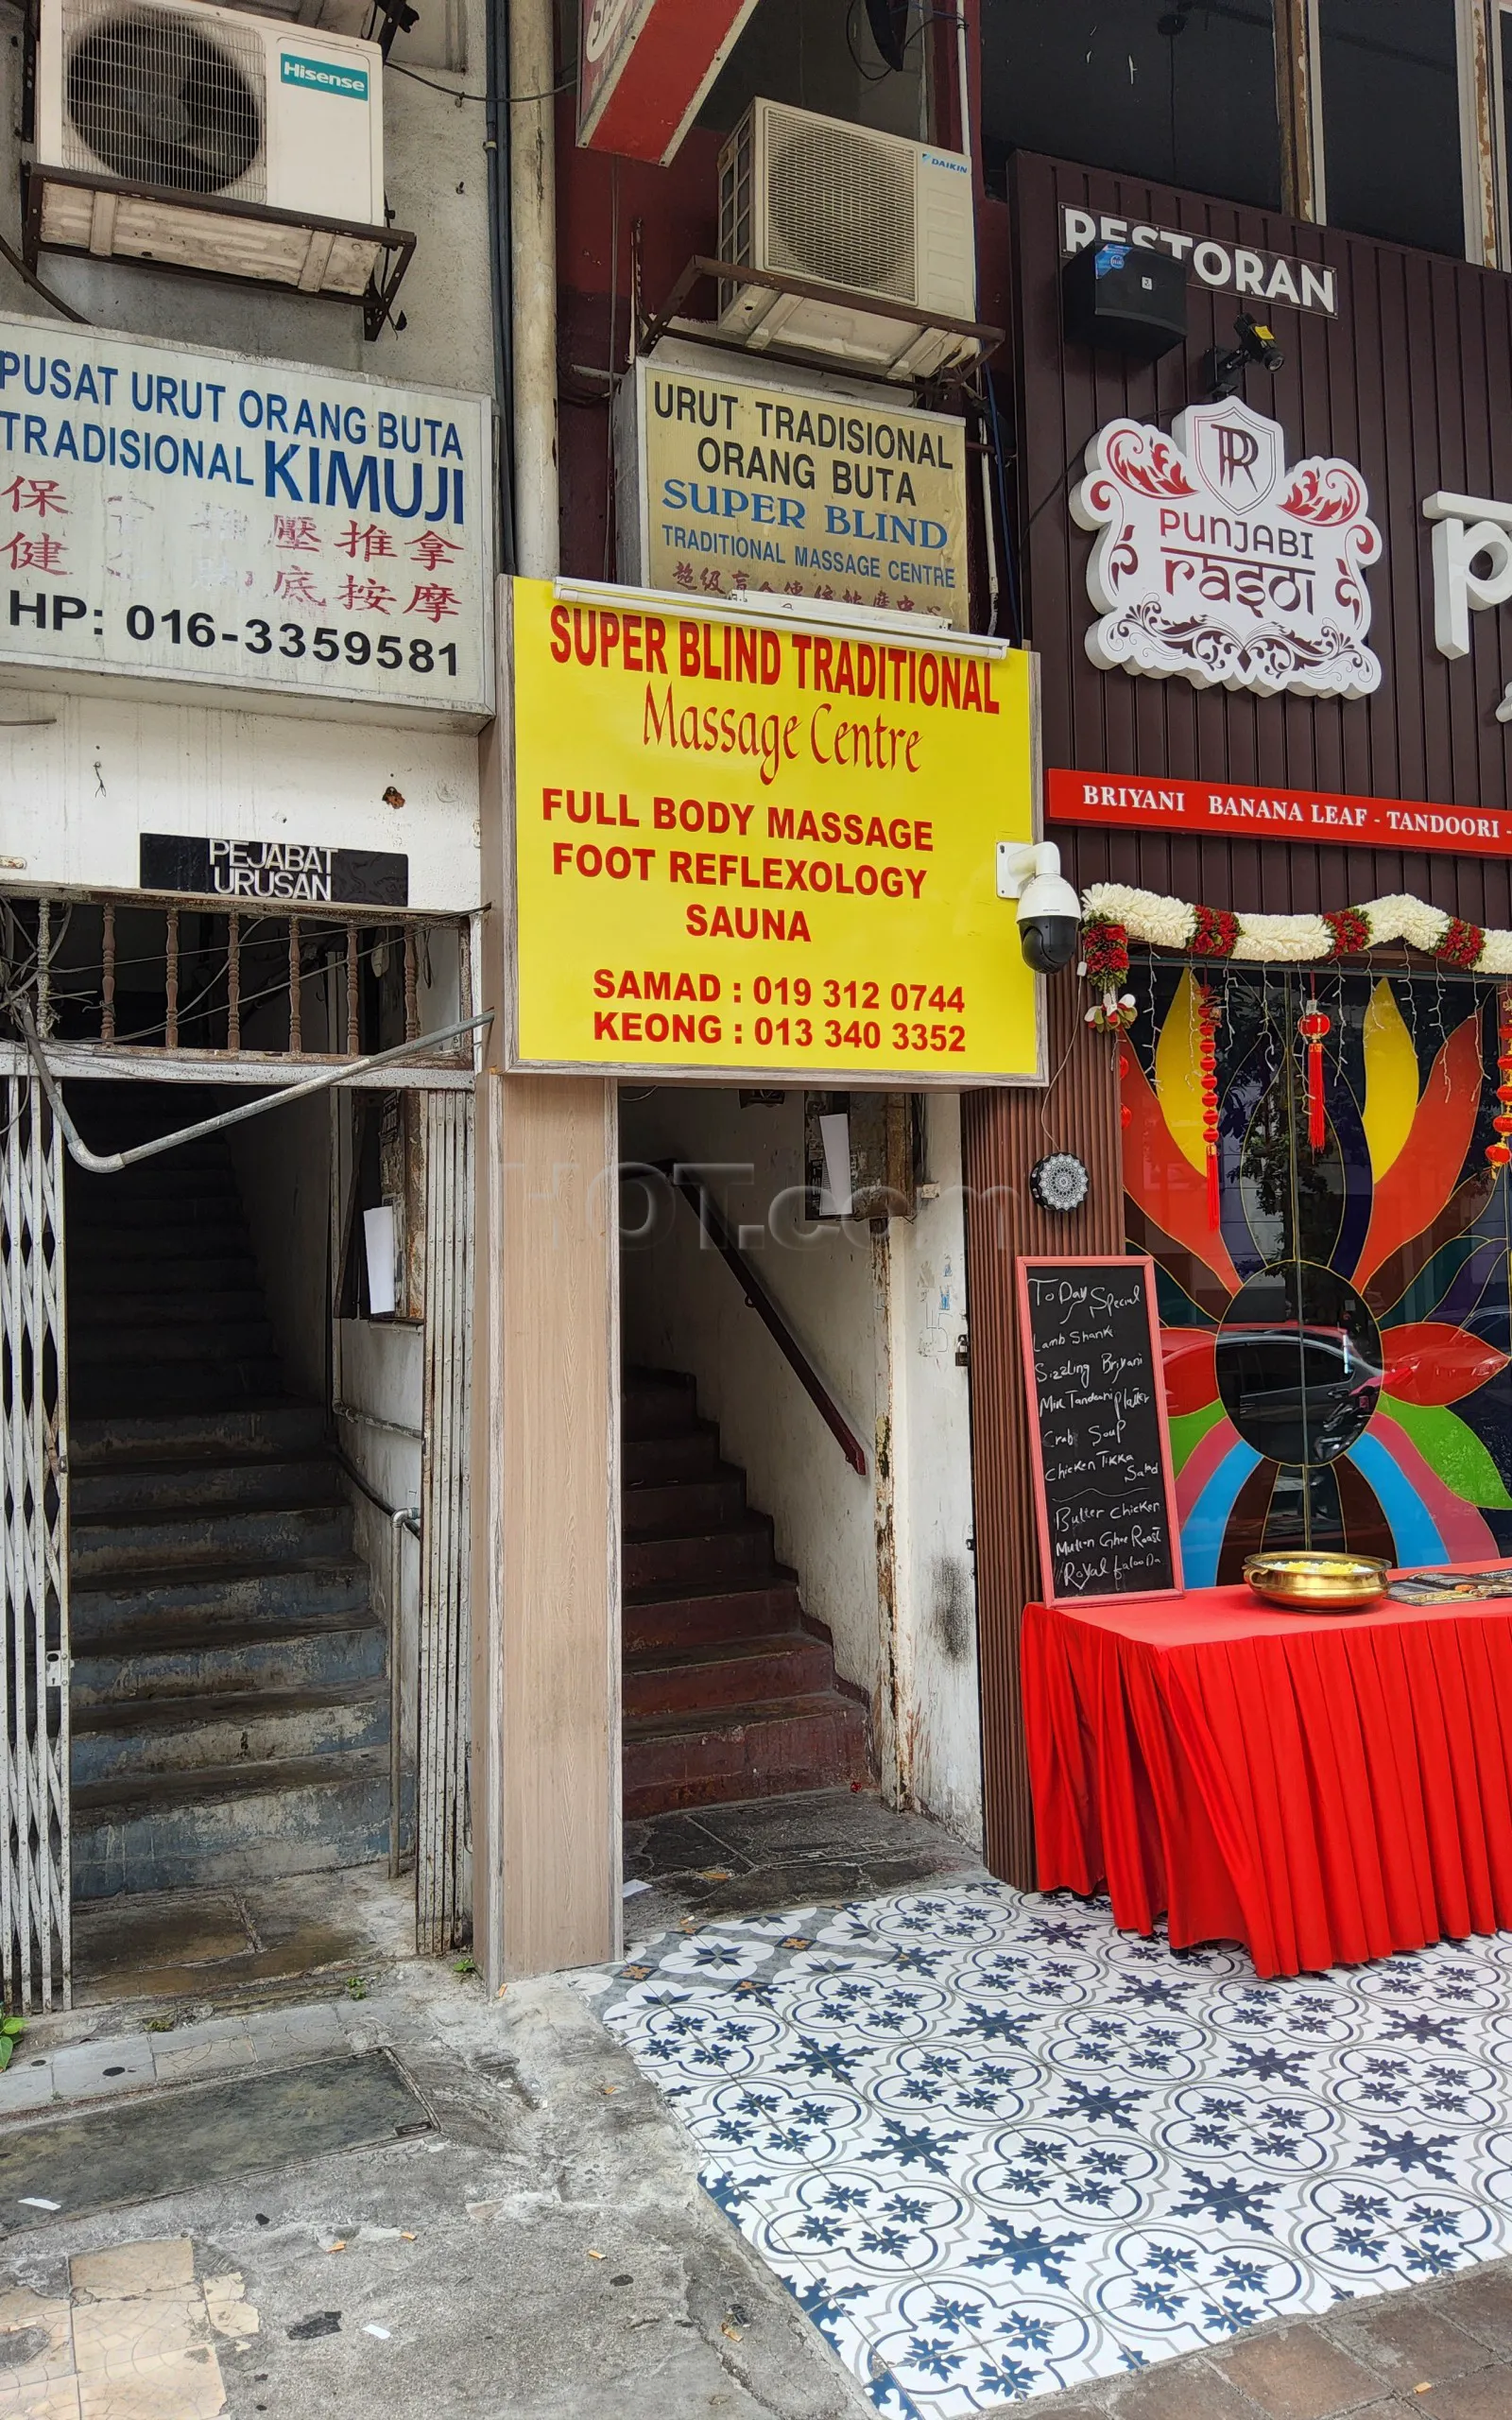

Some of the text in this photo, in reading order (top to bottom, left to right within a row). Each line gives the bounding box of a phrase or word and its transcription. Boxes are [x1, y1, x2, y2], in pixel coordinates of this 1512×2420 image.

[284, 60, 365, 92] Hisense
[931, 158, 968, 173] DAIKIN
[0, 351, 463, 460] PUSAT URUT ORANG BUTA
[654, 381, 953, 470] URUT TRADISIONAL
[0, 411, 464, 525] TRADISIONAL KIMUJI
[697, 437, 917, 507] ORANG BUTA
[662, 478, 948, 549] SUPER BLIND
[662, 524, 955, 589] TRADITIONAL MASSAGE CENTRE
[9, 590, 457, 677] HP: 016-3359581
[550, 605, 1000, 715] SUPER BLIND TRADITIONAL
[644, 681, 923, 786] Massage Centre
[541, 787, 934, 852] FULL BODY MASSAGE
[1083, 785, 1185, 812] BRIYANI
[1208, 795, 1304, 821] BANANA
[1311, 804, 1367, 827] LEAF
[1386, 810, 1500, 838] TANDOORI
[209, 838, 338, 874] PEJABAT
[553, 842, 927, 900] FOOT REFLEXOLOGY
[214, 866, 331, 902] URUSAN
[685, 904, 811, 942] SAUNA
[593, 969, 721, 1003] SAMAD
[753, 977, 811, 1008] 019
[823, 979, 879, 1010] 312
[890, 982, 965, 1013] 0744
[593, 1011, 722, 1046] KEONG
[754, 1018, 813, 1047] 013
[825, 1021, 881, 1050] 340
[892, 1024, 966, 1052] 3352
[1034, 1325, 1113, 1352] Lamb Shank
[1035, 1353, 1143, 1388] Sizzling Briyani
[1043, 1428, 1074, 1447] Crab
[1057, 1507, 1105, 1531] Butter
[1131, 1525, 1161, 1547] Roast
